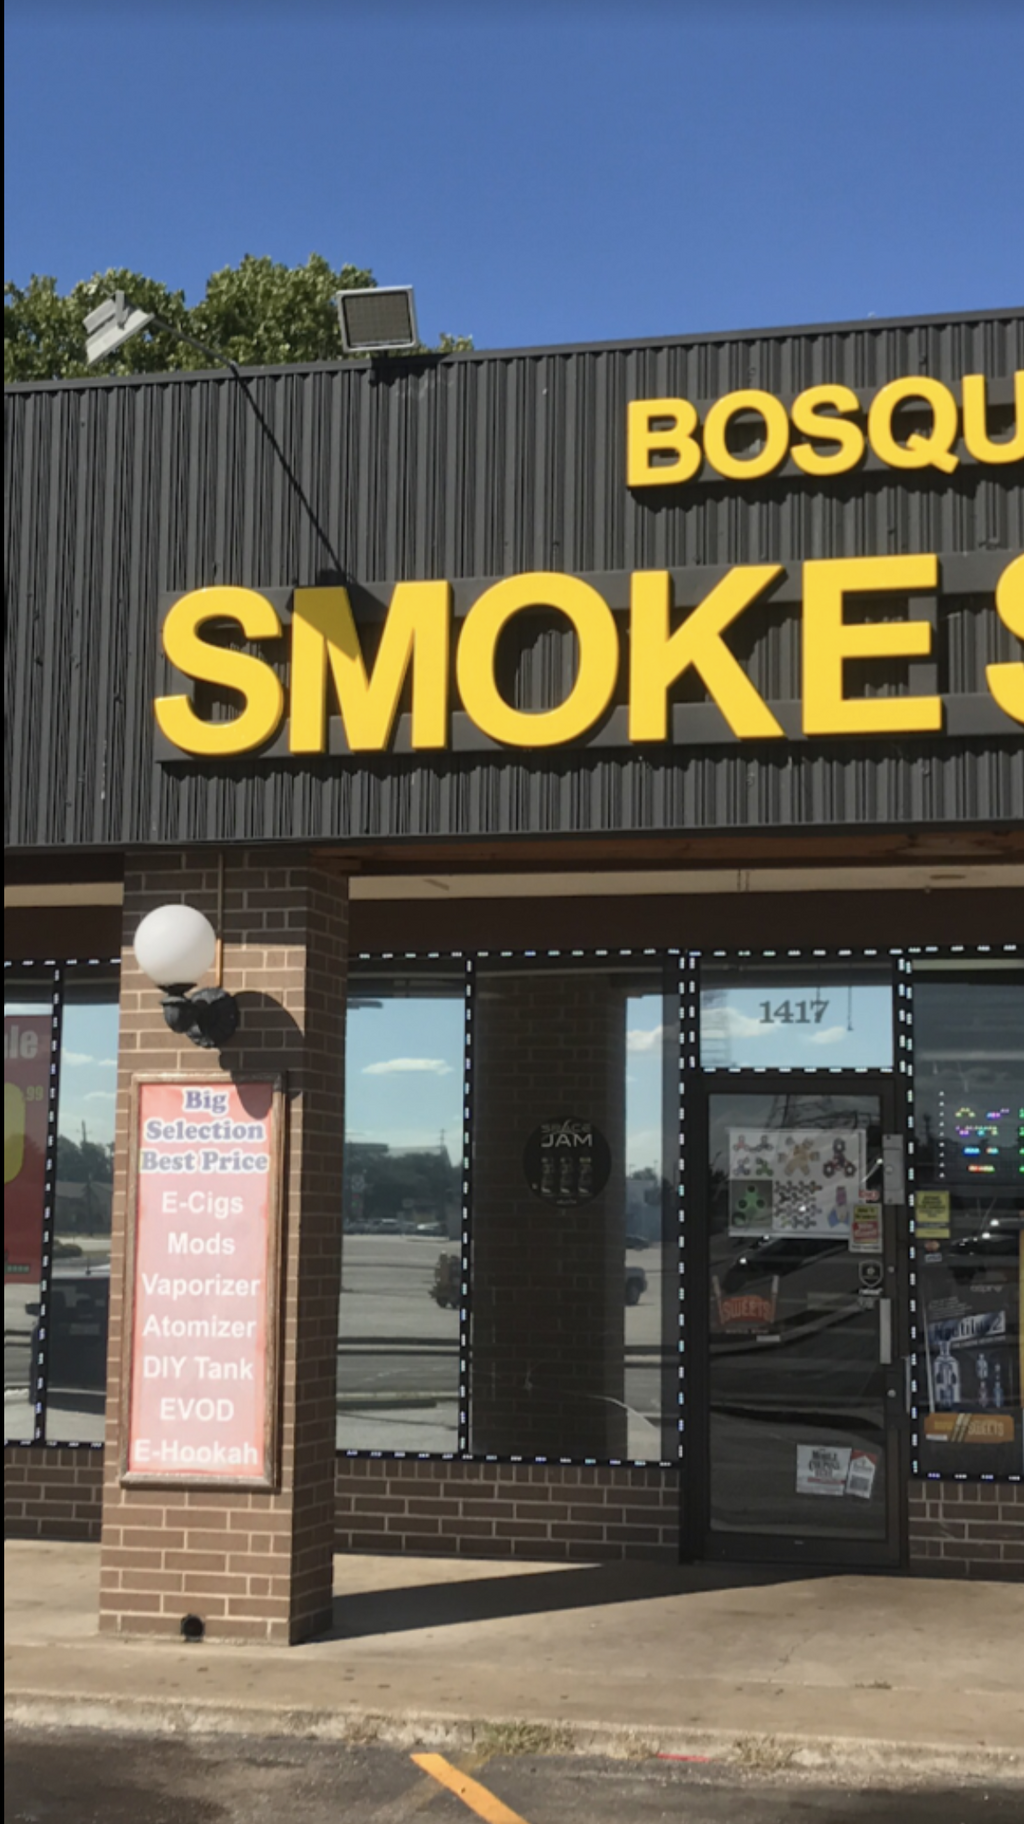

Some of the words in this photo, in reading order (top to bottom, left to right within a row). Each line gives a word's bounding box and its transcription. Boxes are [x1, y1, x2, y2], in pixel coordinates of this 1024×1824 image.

[155, 554, 944, 756] SMOKE
[759, 1000, 829, 1023] 1417
[185, 1090, 227, 1114] Big
[146, 1121, 264, 1140] Selection
[541, 1119, 591, 1134] SPACE
[541, 1134, 592, 1147] JAM
[141, 1151, 195, 1170] Best
[202, 1151, 268, 1170] Price
[162, 1191, 244, 1219] E-Cigs
[168, 1232, 235, 1255] Mods
[142, 1274, 260, 1300] Vaporizer
[142, 1314, 256, 1338] Atomizer
[143, 1356, 187, 1378] DIY
[195, 1356, 253, 1379] Tank
[160, 1398, 235, 1421] EVOD
[134, 1439, 258, 1464] E-Hookah
